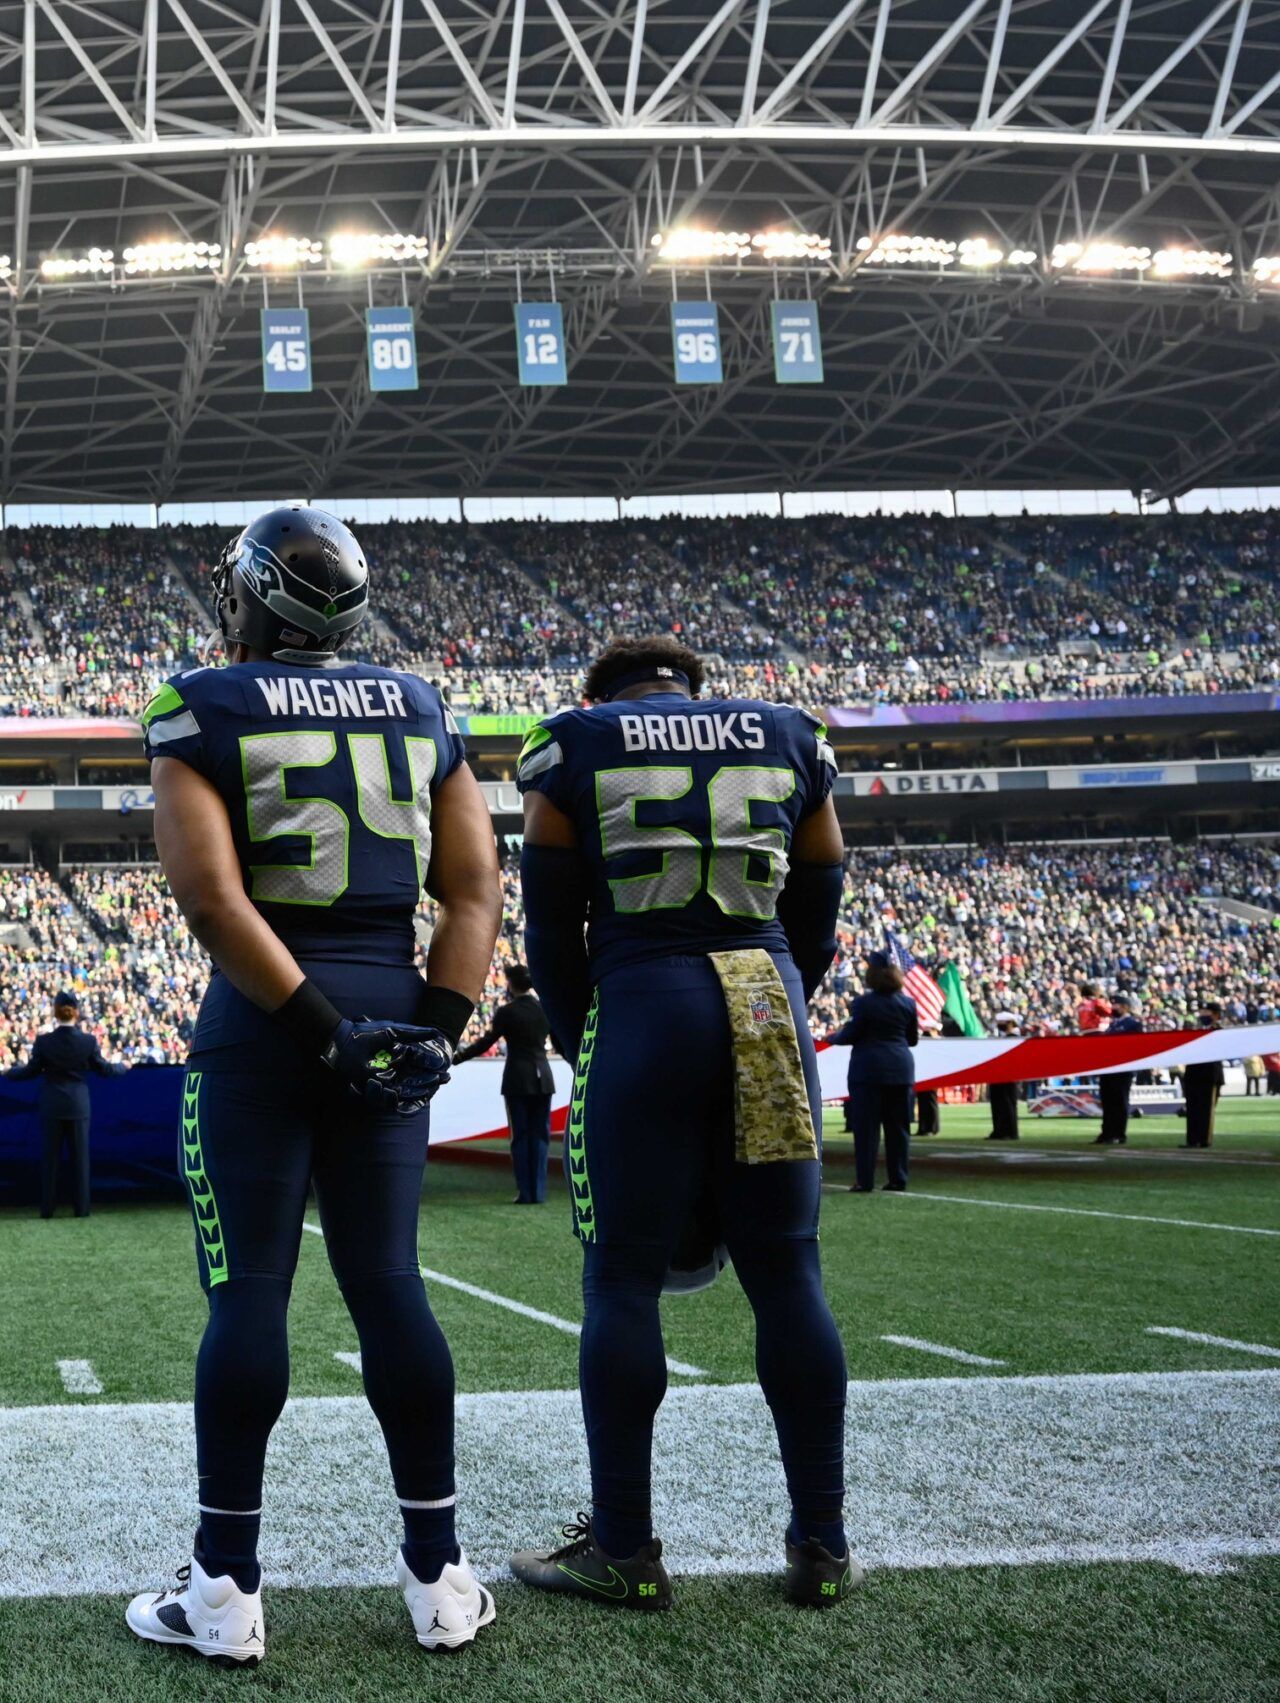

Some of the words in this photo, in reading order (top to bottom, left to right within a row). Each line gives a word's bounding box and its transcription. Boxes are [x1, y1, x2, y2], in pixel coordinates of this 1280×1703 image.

[266, 341, 307, 372] 45
[372, 338, 412, 370] 80
[524, 333, 558, 364] 12
[677, 333, 717, 363] 96
[780, 332, 815, 363] 71
[256, 677, 407, 718] WAGNER
[619, 712, 765, 752] BROOKS
[897, 775, 986, 792] DELTA
[239, 730, 437, 906] 54
[595, 765, 796, 920] 56
[638, 1583, 657, 1596] 56
[820, 1582, 836, 1595] 56
[208, 1628, 220, 1640] 54
